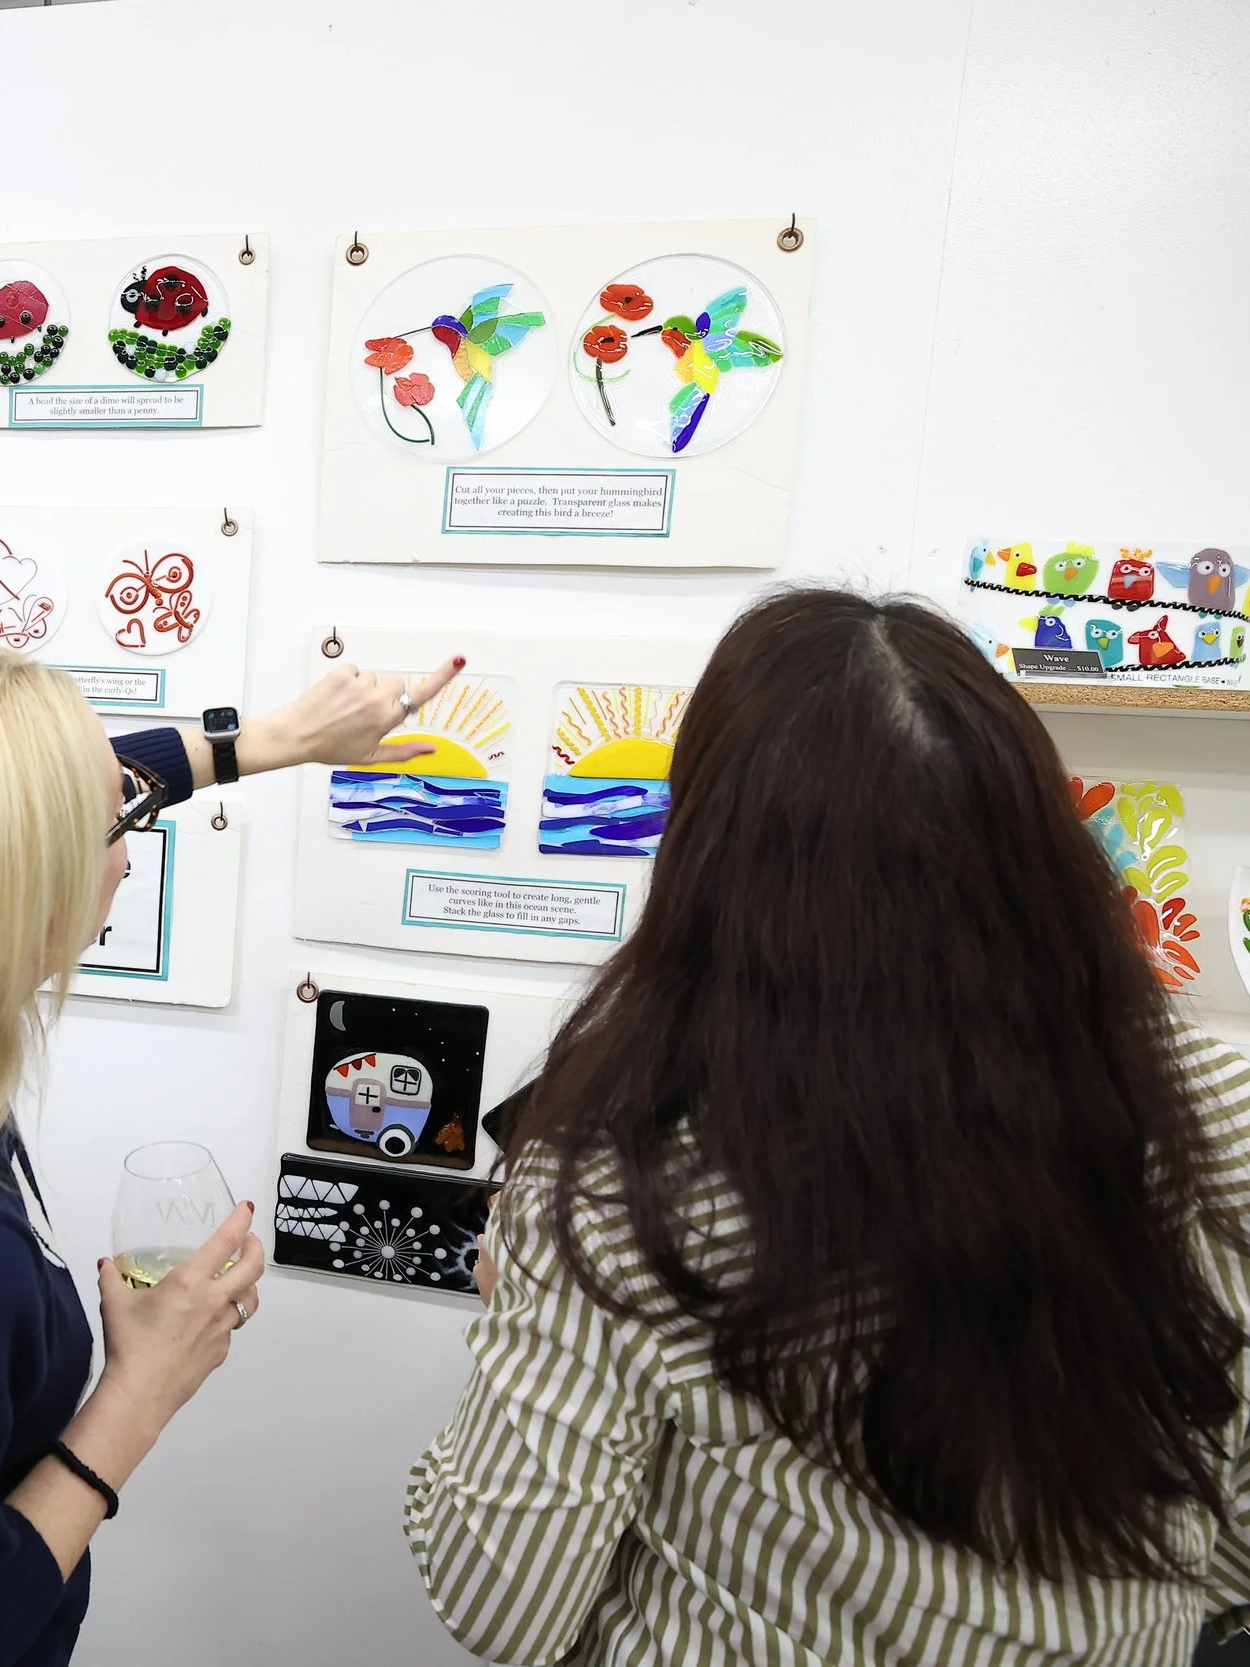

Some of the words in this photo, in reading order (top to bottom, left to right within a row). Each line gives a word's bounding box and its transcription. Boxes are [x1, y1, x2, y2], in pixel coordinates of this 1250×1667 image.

[36, 397, 54, 405] bead
[55, 397, 68, 405] the
[69, 397, 83, 405] size
[84, 396, 93, 404] of
[100, 396, 120, 404] dime
[121, 396, 135, 404] will
[136, 396, 163, 406] spread
[174, 396, 184, 404] be
[50, 407, 77, 416] slightly
[78, 407, 107, 415] smaller
[108, 407, 126, 415] than
[455, 486, 470, 494] Cut
[472, 485, 484, 494] all
[485, 487, 506, 495] your
[507, 487, 537, 496] pieces,
[538, 486, 559, 494] then
[561, 487, 575, 497] put
[577, 487, 599, 497] your
[600, 487, 663, 498] hummingbird
[454, 497, 491, 506] together
[492, 497, 508, 505] like
[517, 497, 548, 507] puzzle.
[552, 498, 606, 508] Transparent
[608, 499, 631, 509] glass
[632, 499, 662, 508] makes
[498, 508, 534, 518] creating
[535, 509, 552, 517] this
[554, 509, 572, 517] bird
[581, 509, 614, 518] breeze!
[1043, 654, 1070, 662] Wave
[134, 678, 146, 686] the
[1111, 674, 1143, 682] SMALL
[1146, 674, 1200, 683] RECTANGLE
[1201, 676, 1220, 685] BASE
[83, 685, 90, 693] in
[91, 685, 104, 693] the
[104, 687, 137, 695] curly-Qs!
[428, 884, 445, 893] Use
[446, 886, 460, 894] the
[461, 887, 492, 898] scoring
[494, 890, 511, 899] tool
[523, 893, 549, 901] create
[550, 893, 572, 905] long,
[574, 896, 601, 906] gentle
[449, 898, 476, 906] curves
[477, 898, 493, 907] like
[495, 899, 504, 908] in
[505, 900, 522, 909] this
[523, 903, 549, 911] ocean
[550, 905, 577, 914] scene.
[443, 906, 466, 916] Stack
[468, 907, 482, 916] the
[483, 909, 505, 919] glass
[506, 911, 515, 919] to
[516, 911, 528, 921] fill
[529, 912, 539, 921] in
[540, 915, 556, 924] any
[557, 916, 581, 925] gaps.
